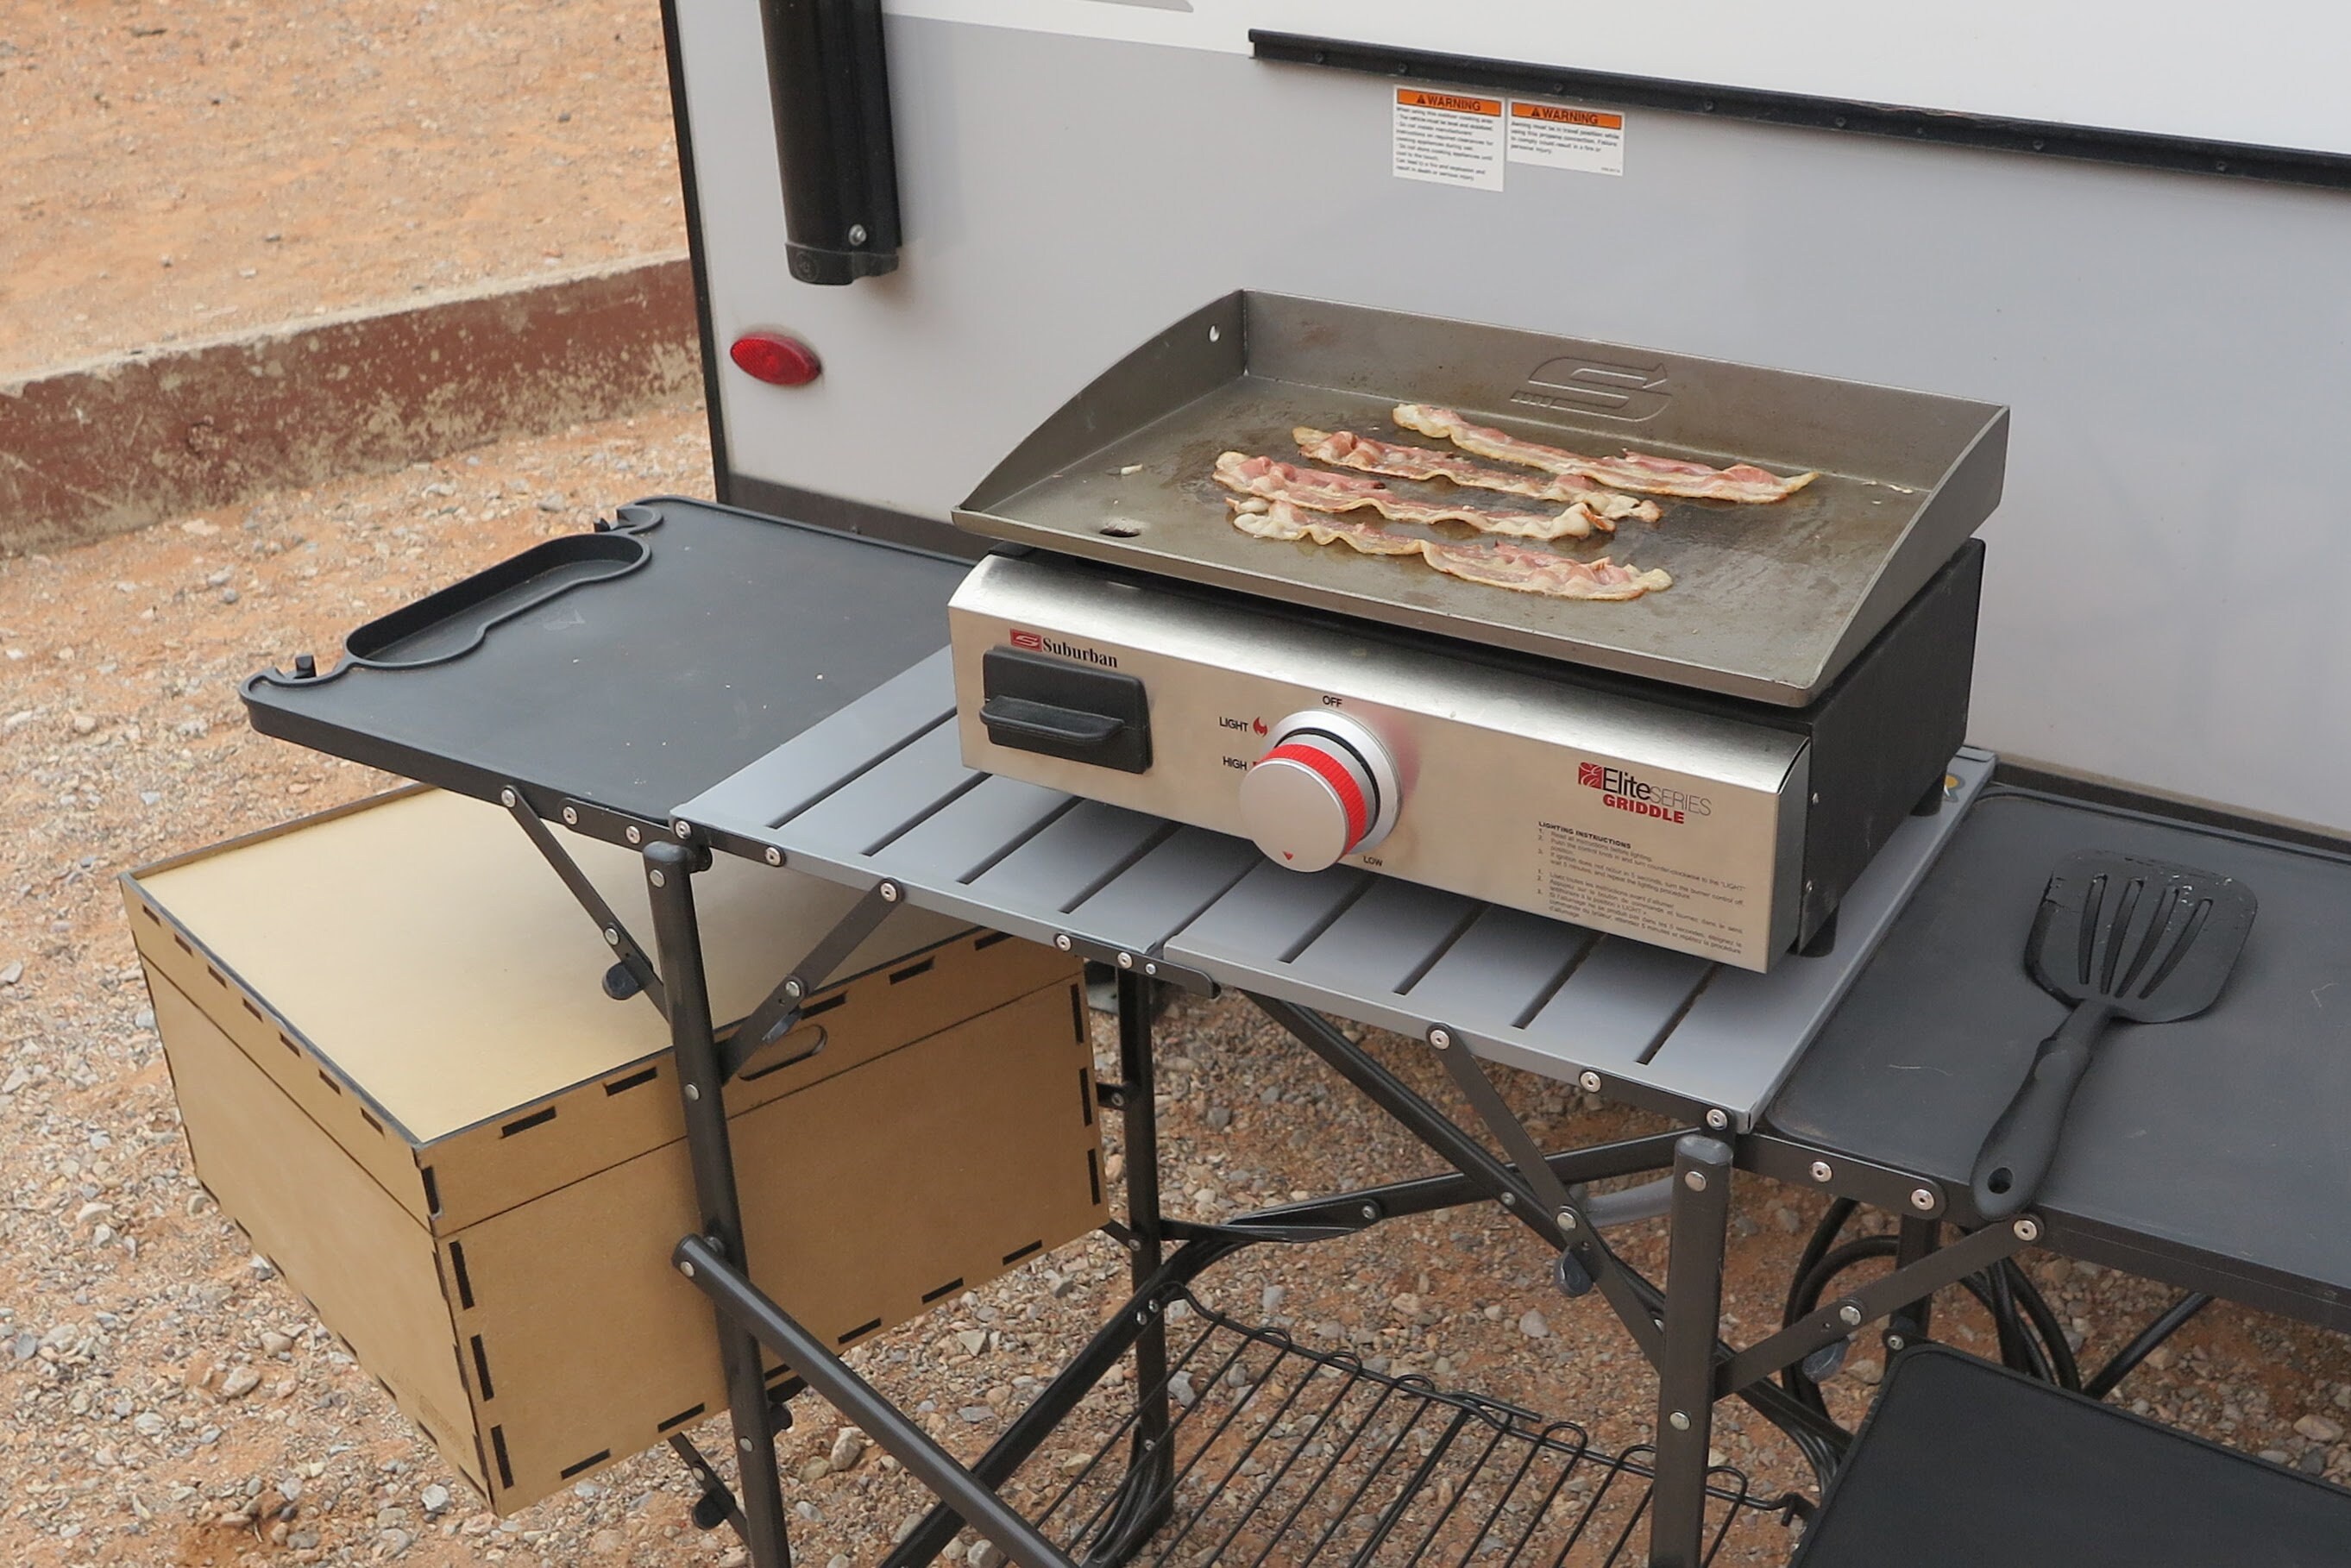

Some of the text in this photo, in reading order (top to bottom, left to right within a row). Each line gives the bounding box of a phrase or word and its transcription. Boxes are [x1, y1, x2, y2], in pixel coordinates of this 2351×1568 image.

[1428, 95, 1481, 112] WARNING
[1543, 108, 1599, 124] WARNING
[1042, 637, 1118, 668] Suburban
[1322, 694, 1342, 707] OFF
[1219, 716, 1248, 732] LIGHT
[1223, 756, 1248, 770] HIGH
[1602, 793, 1685, 825] GRIDDLE
[1538, 821, 1631, 850] LIGHTING INSTRUCTIONS
[1363, 855, 1383, 867] LOW
